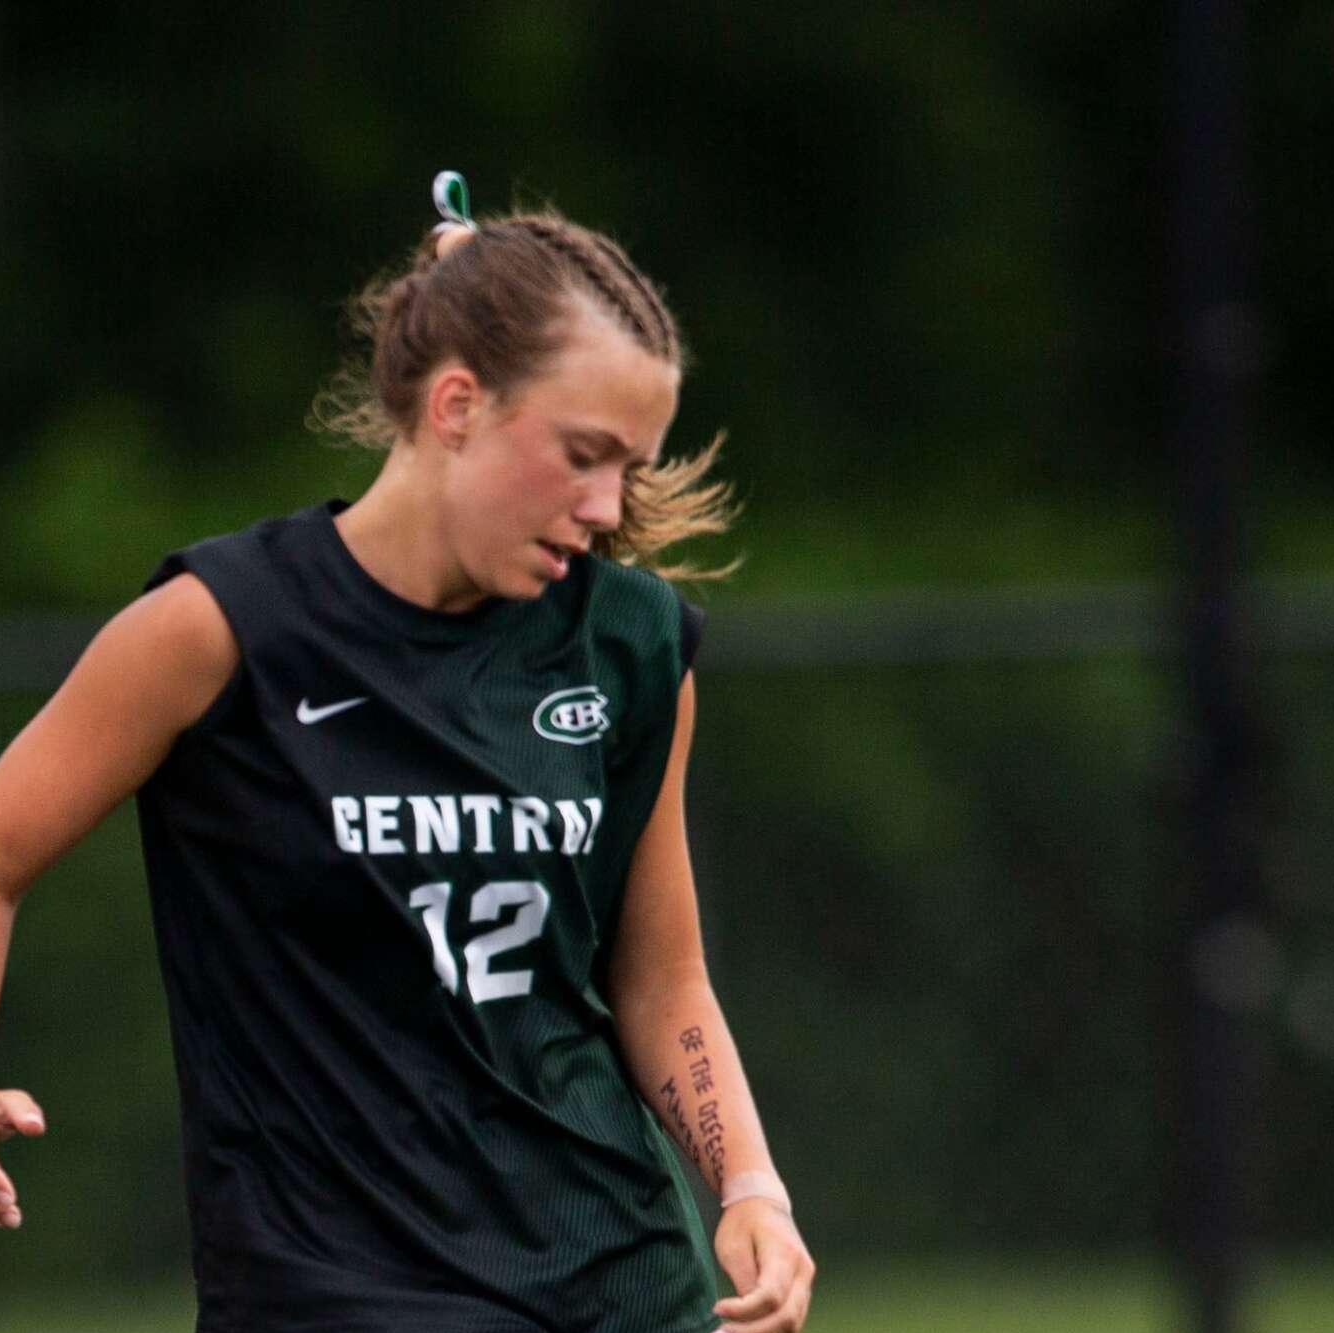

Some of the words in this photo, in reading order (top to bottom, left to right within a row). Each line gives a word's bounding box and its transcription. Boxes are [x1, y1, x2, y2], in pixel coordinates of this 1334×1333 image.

[409, 881, 550, 1004] 12
[679, 1025, 705, 1053] BE
[689, 1056, 714, 1096] THE
